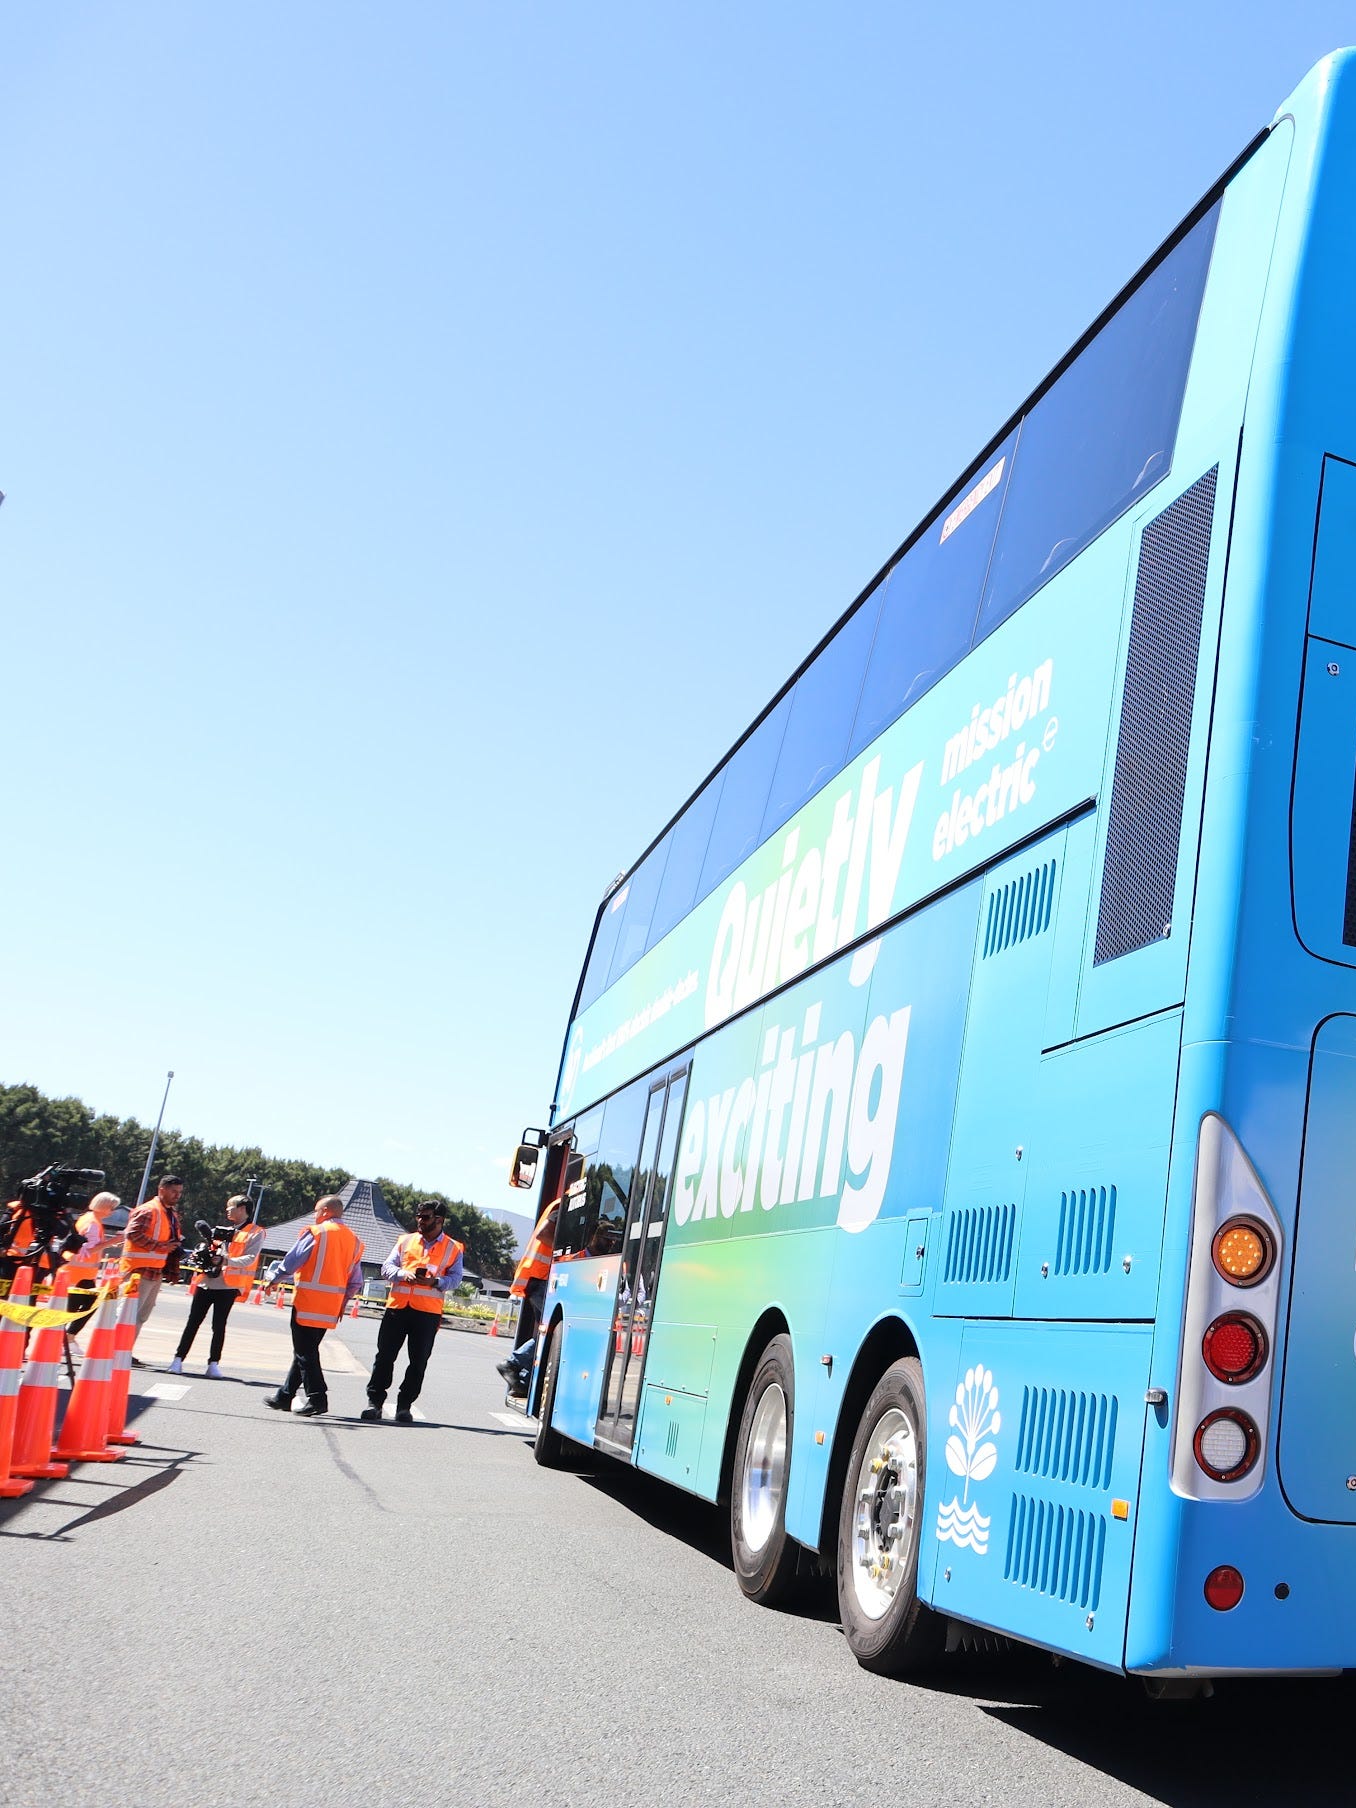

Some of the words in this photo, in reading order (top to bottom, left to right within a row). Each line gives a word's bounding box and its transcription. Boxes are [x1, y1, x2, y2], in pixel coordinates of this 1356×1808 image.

[932, 747, 1041, 861] electric
[940, 659, 1053, 786] mission
[704, 754, 924, 1028] Quietly
[673, 1001, 912, 1234] exciting
